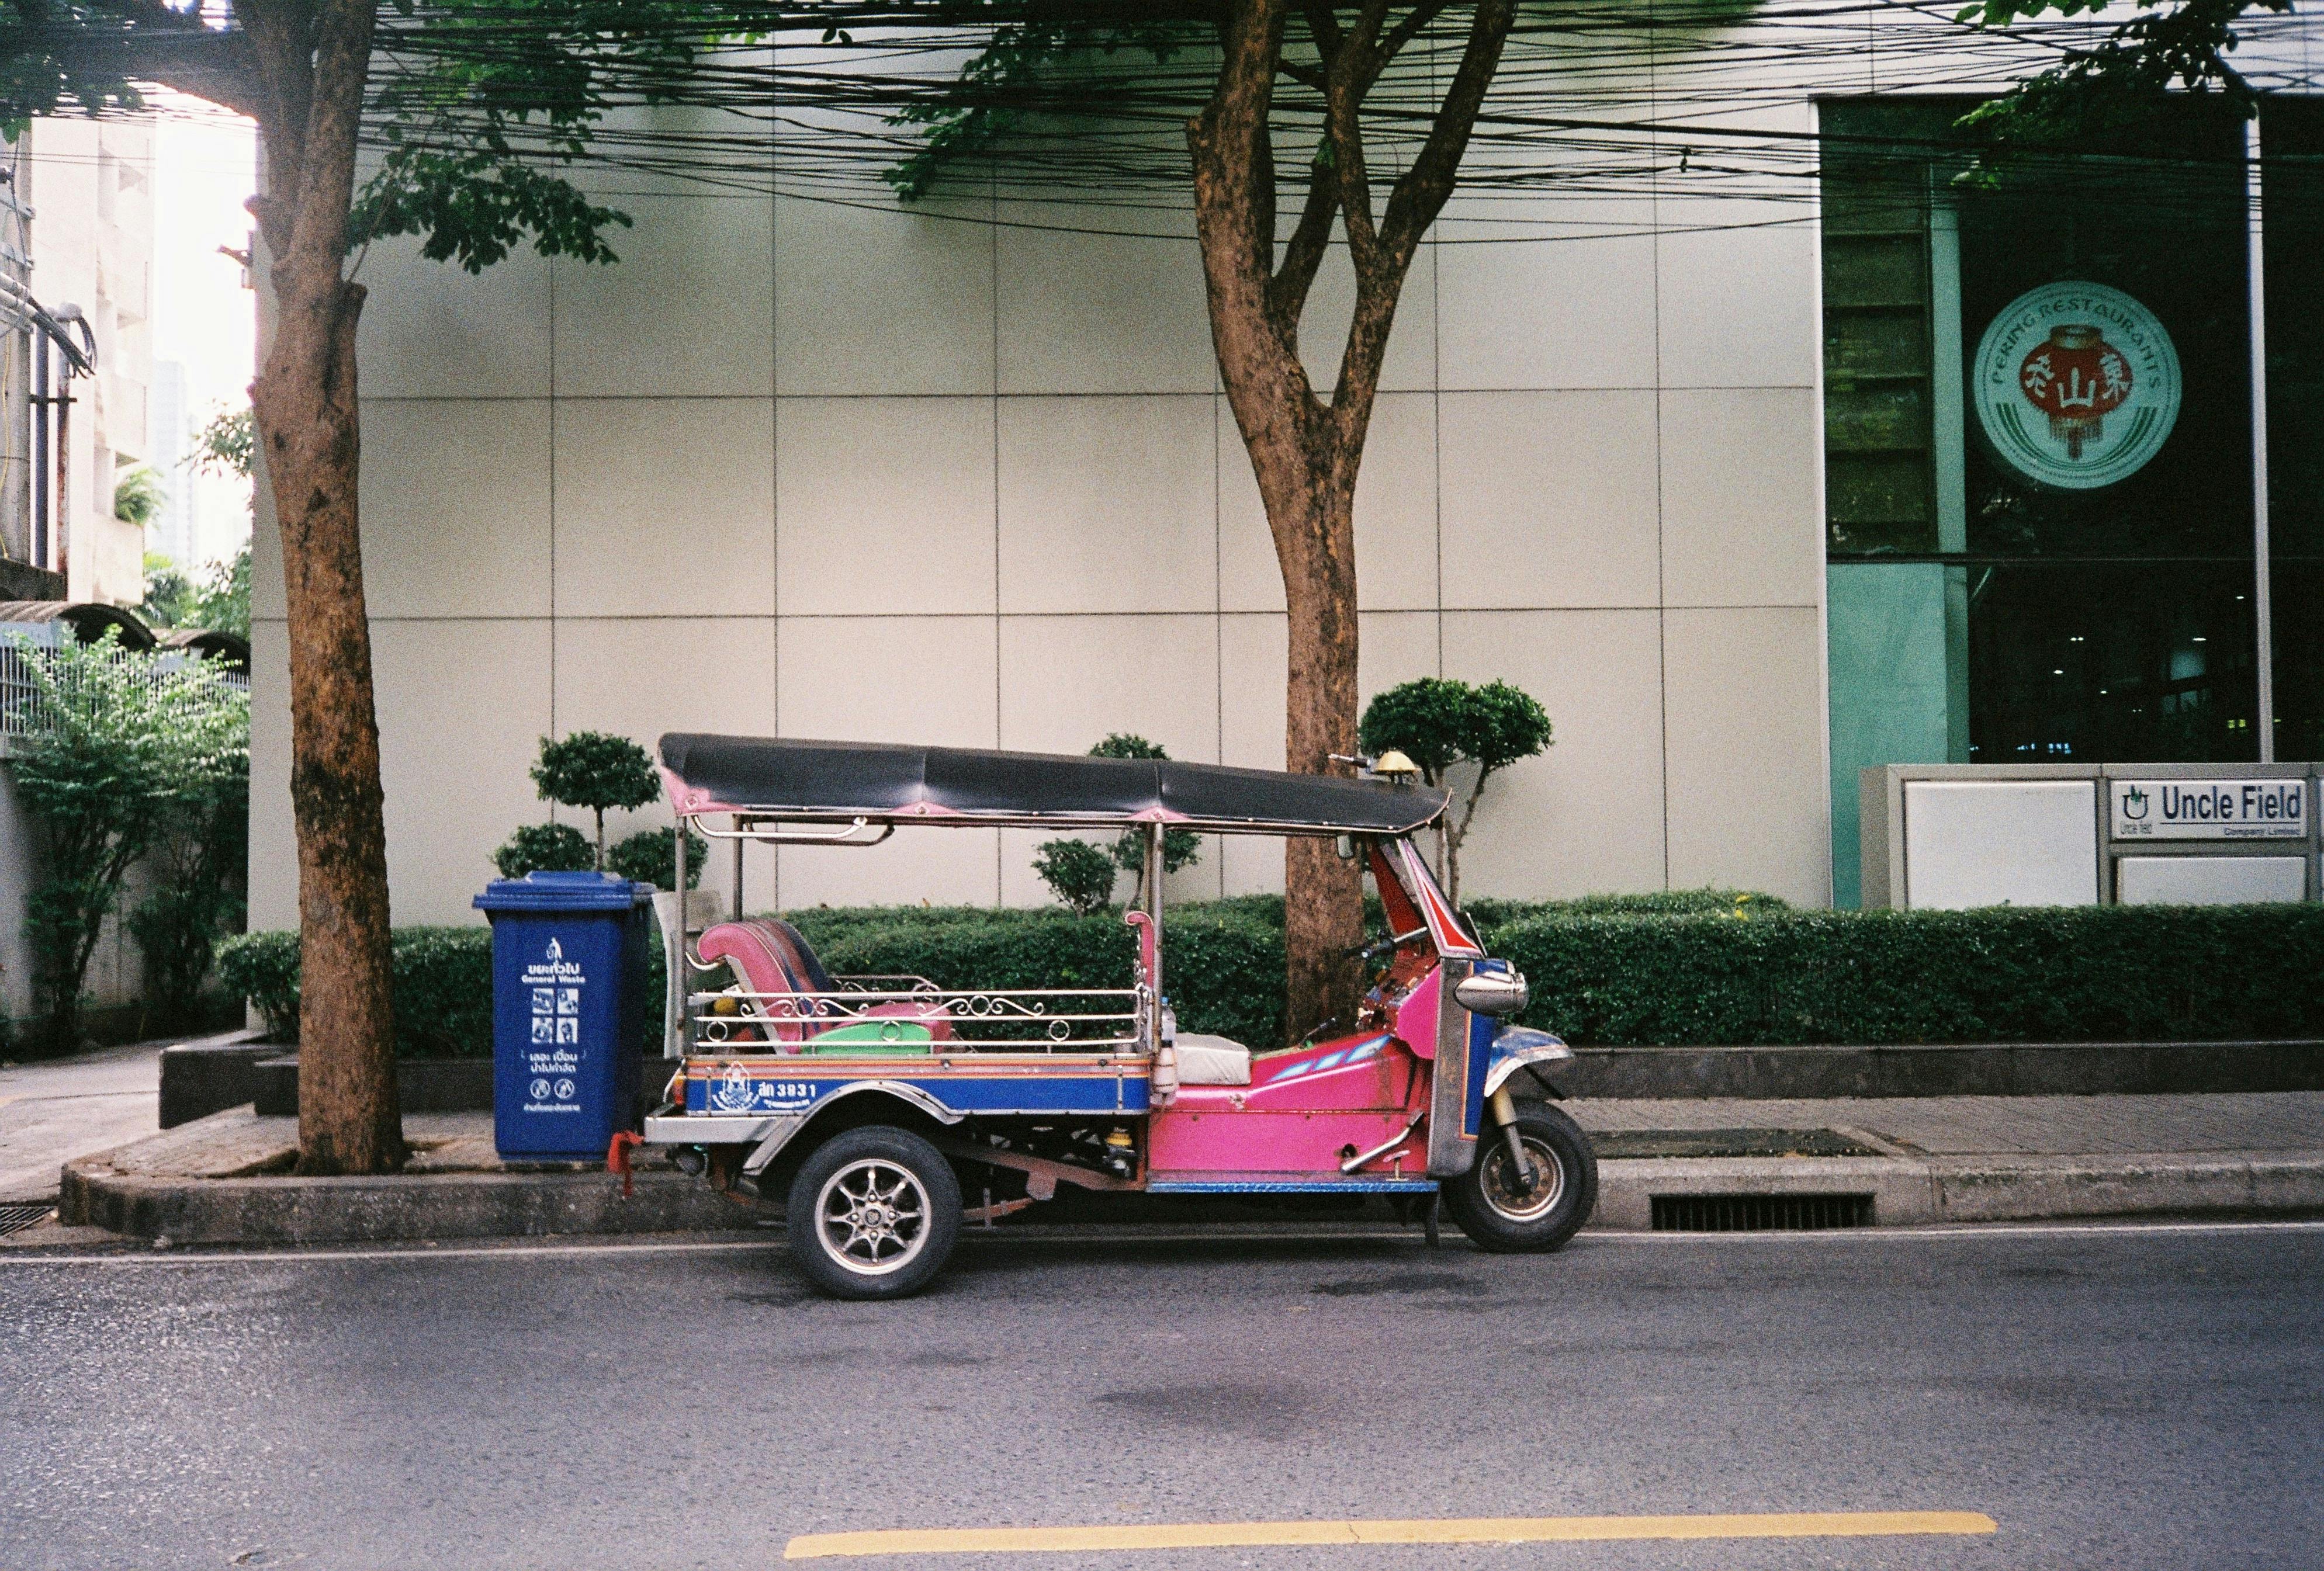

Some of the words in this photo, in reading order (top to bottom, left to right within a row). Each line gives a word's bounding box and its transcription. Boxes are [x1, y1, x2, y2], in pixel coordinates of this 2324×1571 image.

[2038, 297, 2162, 389] RESTAURANTS
[2162, 786, 2233, 819] Uncle
[2242, 786, 2301, 819] Field
[521, 974, 556, 984] General
[557, 974, 586, 984] Waste
